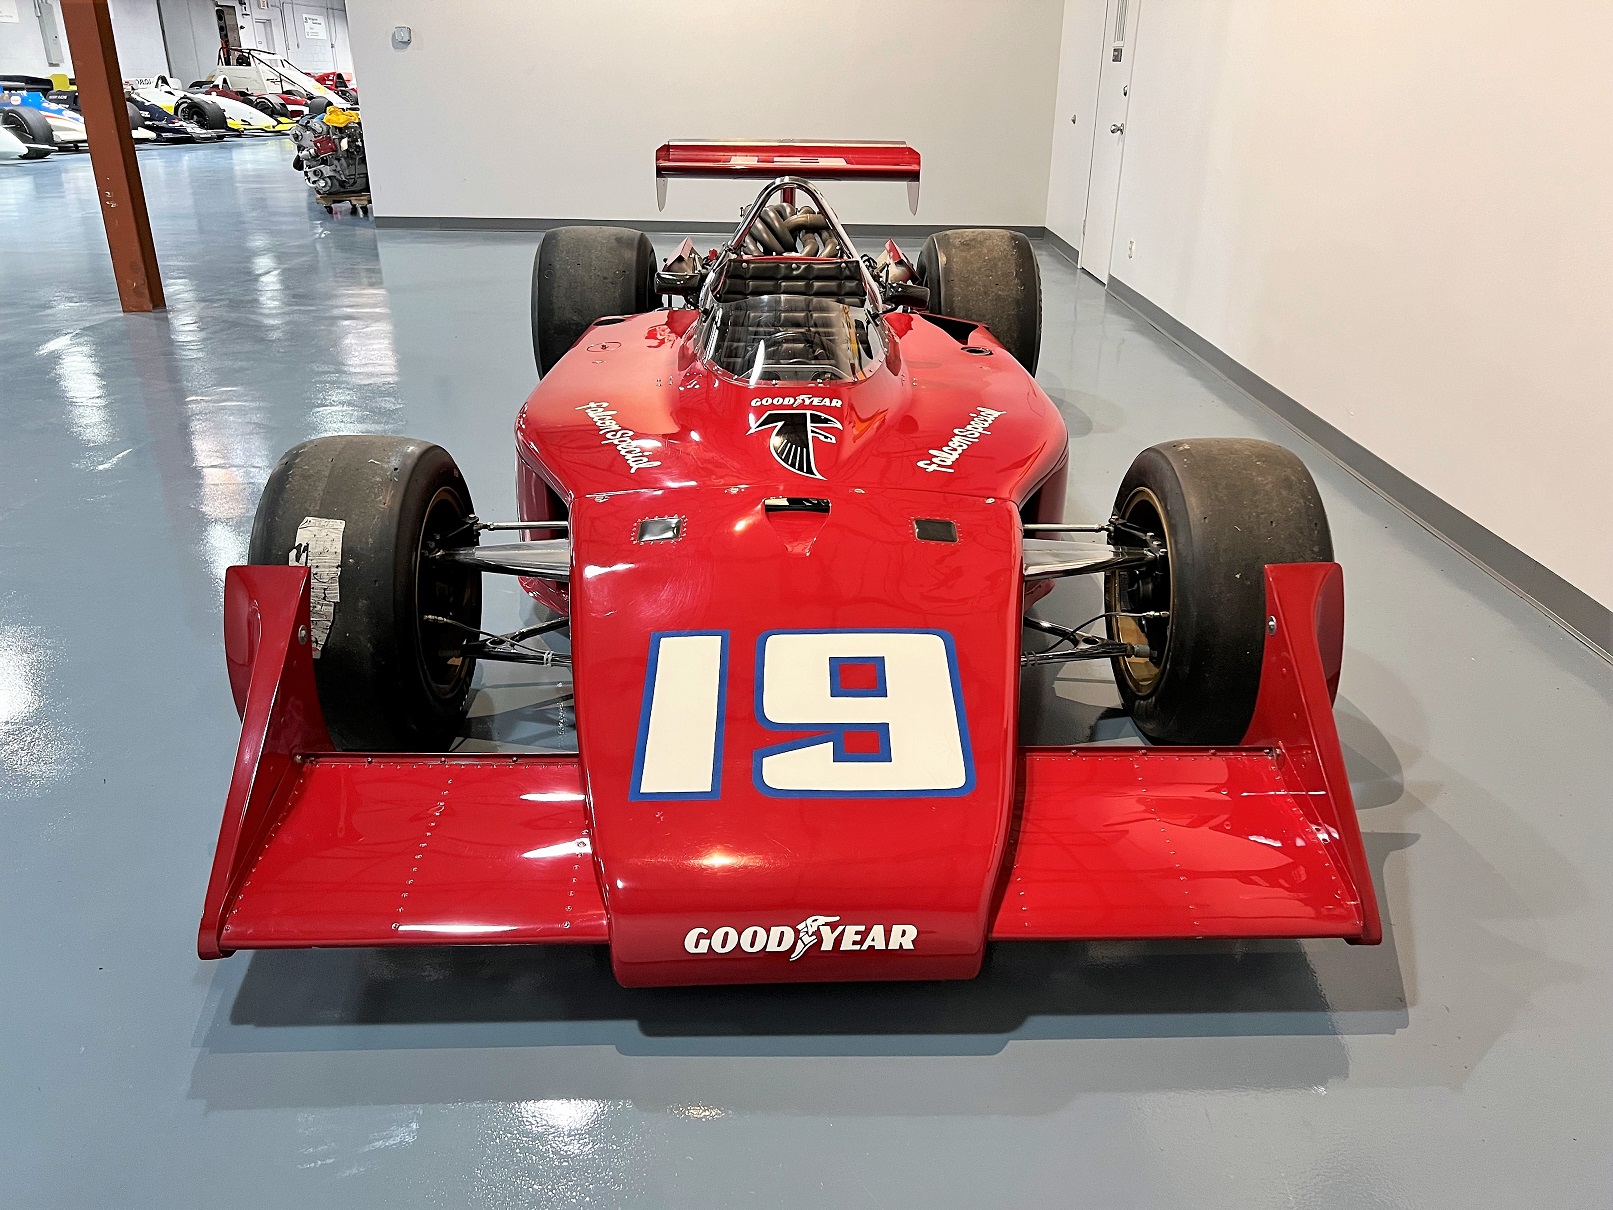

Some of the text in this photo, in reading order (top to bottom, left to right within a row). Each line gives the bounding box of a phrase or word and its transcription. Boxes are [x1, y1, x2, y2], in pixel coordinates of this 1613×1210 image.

[750, 396, 843, 408] GOODYEAR
[953, 406, 1007, 438] Special
[600, 429, 662, 474] Special
[628, 628, 976, 802] 19
[684, 924, 918, 954] GOODYEAR
